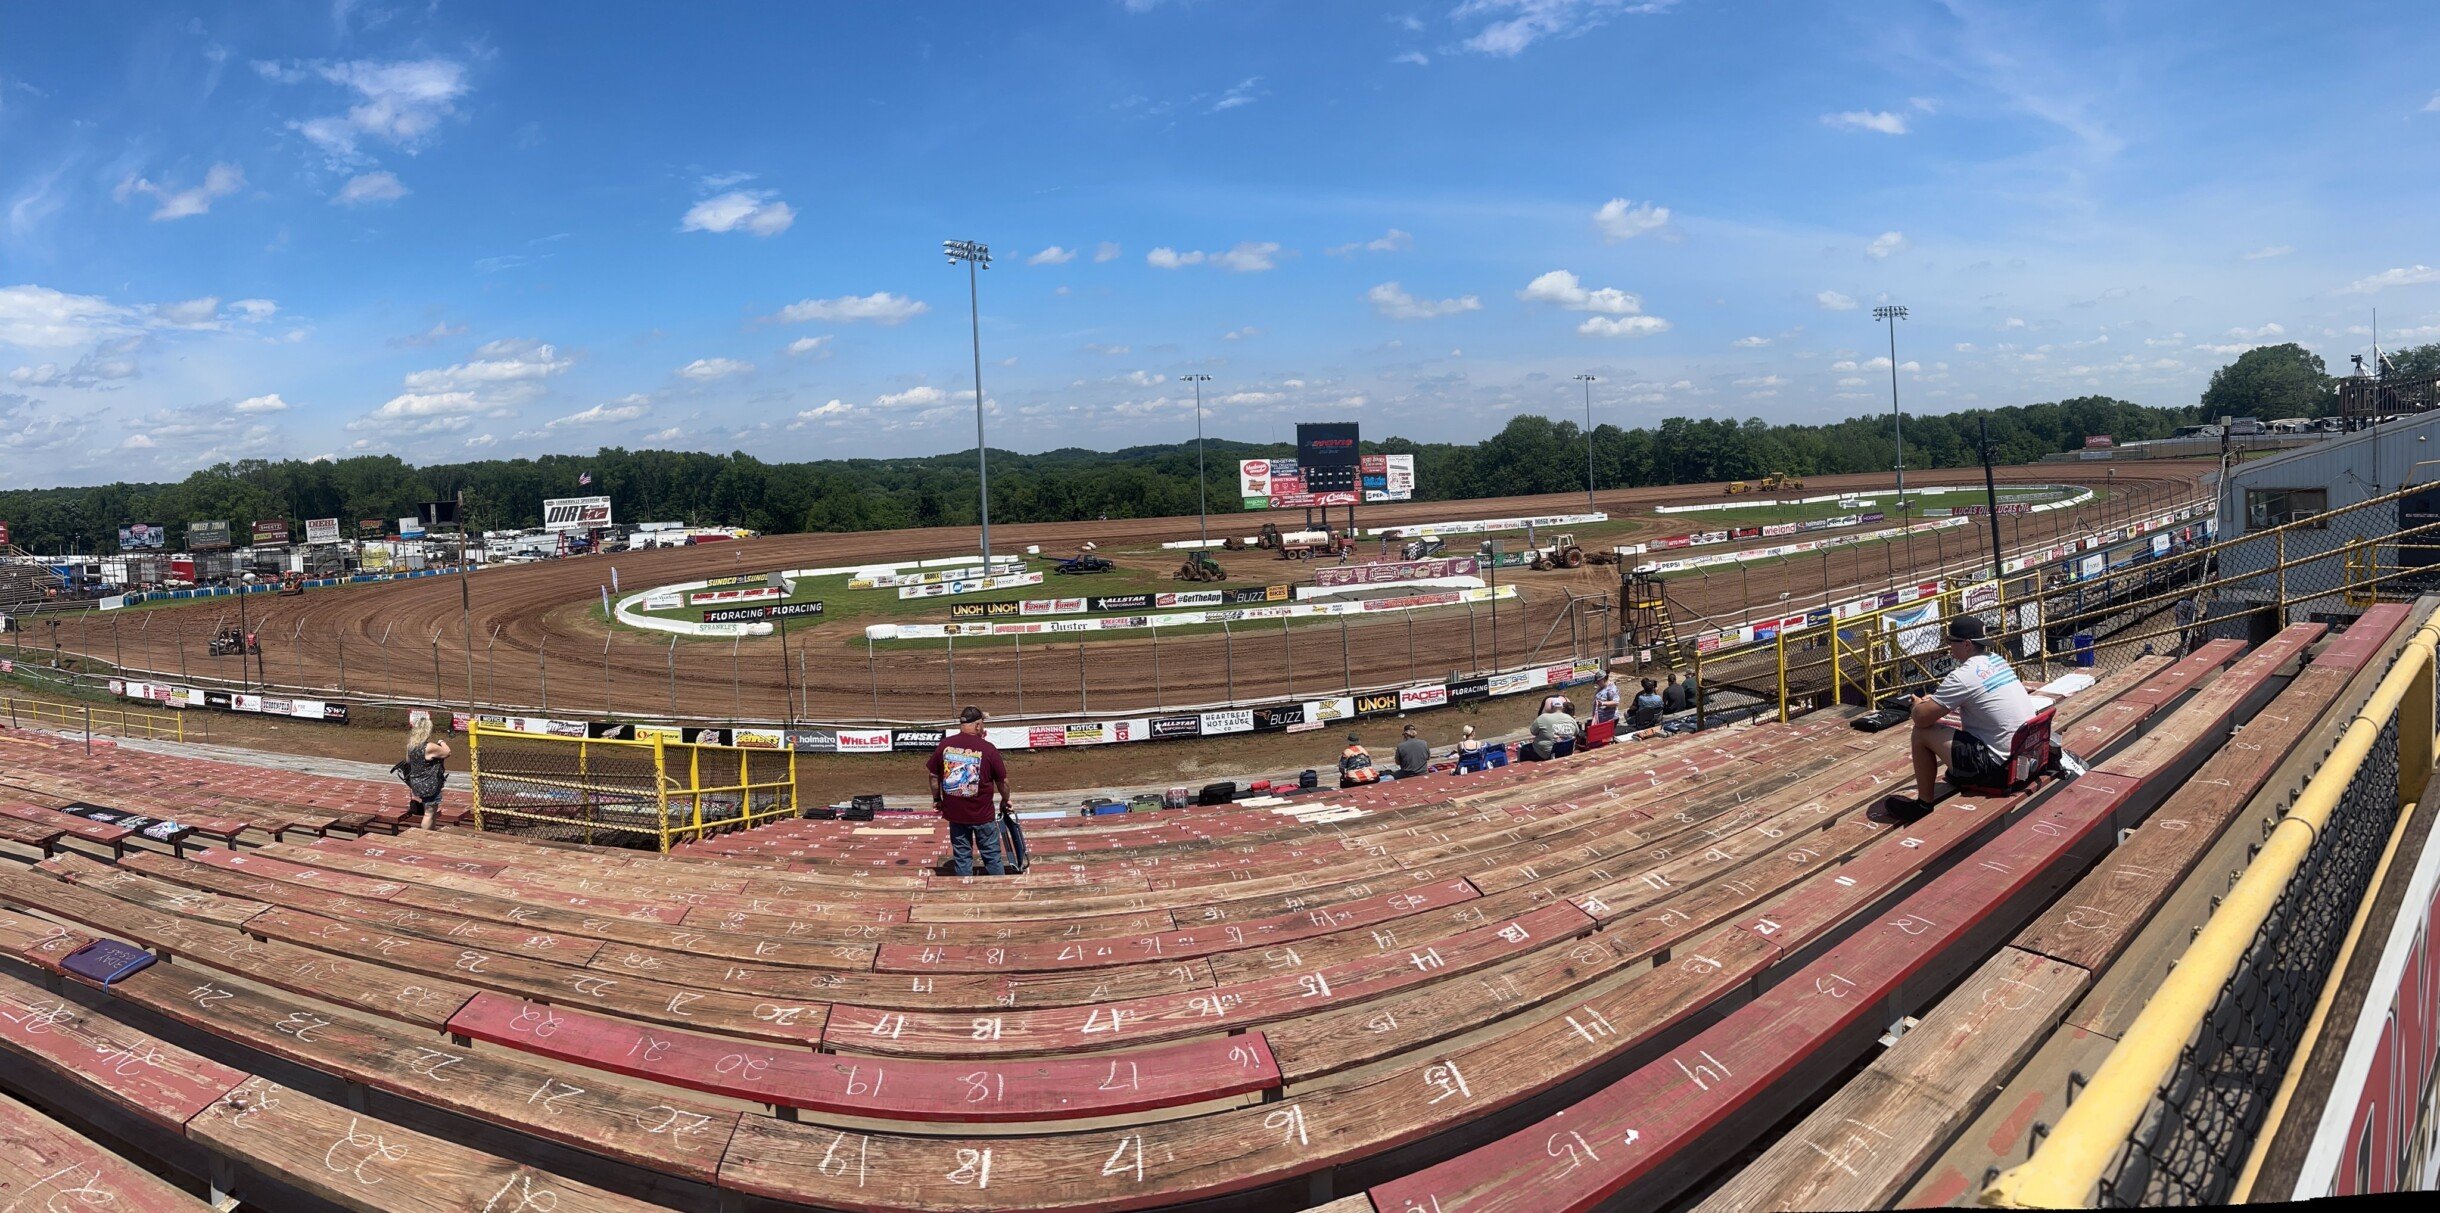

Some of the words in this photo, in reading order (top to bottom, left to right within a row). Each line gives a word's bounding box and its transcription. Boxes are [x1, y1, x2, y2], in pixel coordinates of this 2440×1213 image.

[547, 505, 589, 523] DIRT
[1955, 507, 1977, 515] LUCAS
[2018, 504, 2031, 512] OIL
[1764, 524, 1795, 535] wieland
[708, 577, 737, 586] SUNOCO
[747, 573, 768, 583] SUNO
[1178, 593, 1221, 603] #GetTheApp
[1237, 592, 1265, 602] BUZZ
[710, 609, 764, 621] FLORACING
[772, 603, 823, 616] FLORACING
[953, 605, 984, 615] UNOH
[987, 603, 1018, 614] UNOH
[1402, 689, 1446, 702] RACER
[1451, 684, 1488, 697] FLORACING
[1359, 696, 1397, 711] UNOH
[1205, 711, 1250, 720] HEARTBEAT
[1270, 711, 1303, 725] BUZZ
[799, 735, 836, 744] holmatro
[840, 735, 889, 746] WHELEN
[896, 732, 942, 741] PENSKE
[1641, 873, 1671, 890] 11
[1834, 875, 1857, 888] 11
[1409, 947, 1444, 972] 14
[1300, 971, 1331, 998] 15
[871, 1013, 905, 1040] 19
[1081, 1008, 1120, 1035] 17
[1367, 1011, 1398, 1034] 15
[1564, 1003, 1618, 1043] 14
[971, 1017, 1000, 1041] 18
[845, 1064, 882, 1098] 19
[1098, 1059, 1139, 1091] 17
[956, 1070, 1004, 1102] 18
[1424, 1060, 1472, 1105] 15
[1264, 1104, 1309, 1147] 16
[818, 1131, 869, 1188] 19
[1101, 1135, 1143, 1182] 17
[946, 1147, 992, 1189] 18
